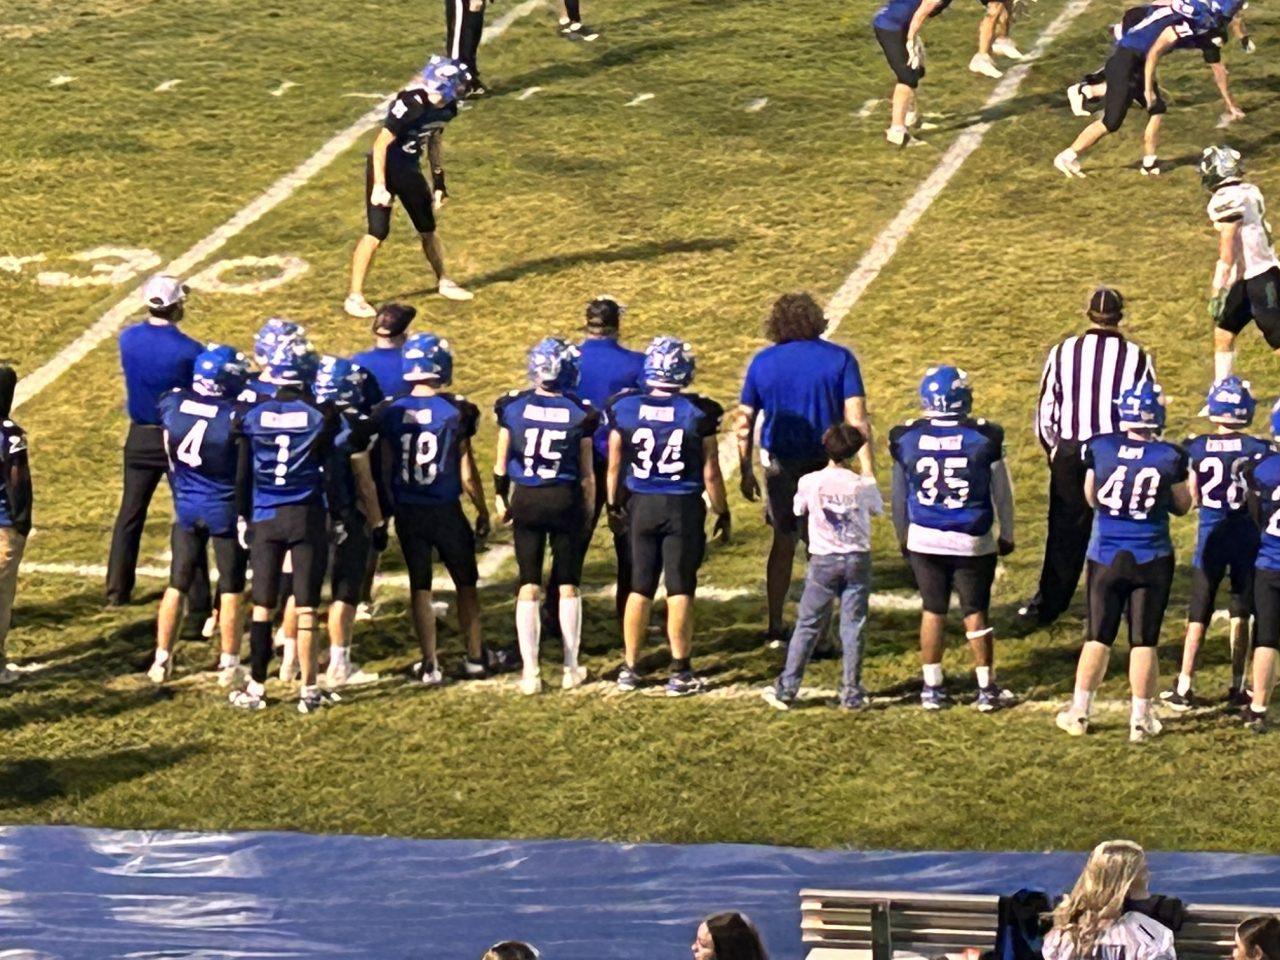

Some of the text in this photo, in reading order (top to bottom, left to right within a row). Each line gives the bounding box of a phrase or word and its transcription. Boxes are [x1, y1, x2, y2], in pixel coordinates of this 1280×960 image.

[176, 419, 209, 467] 4
[273, 434, 291, 486] 1
[523, 427, 568, 480] 15
[630, 427, 685, 482] 34
[915, 456, 970, 510] 35
[1097, 465, 1161, 520] 40
